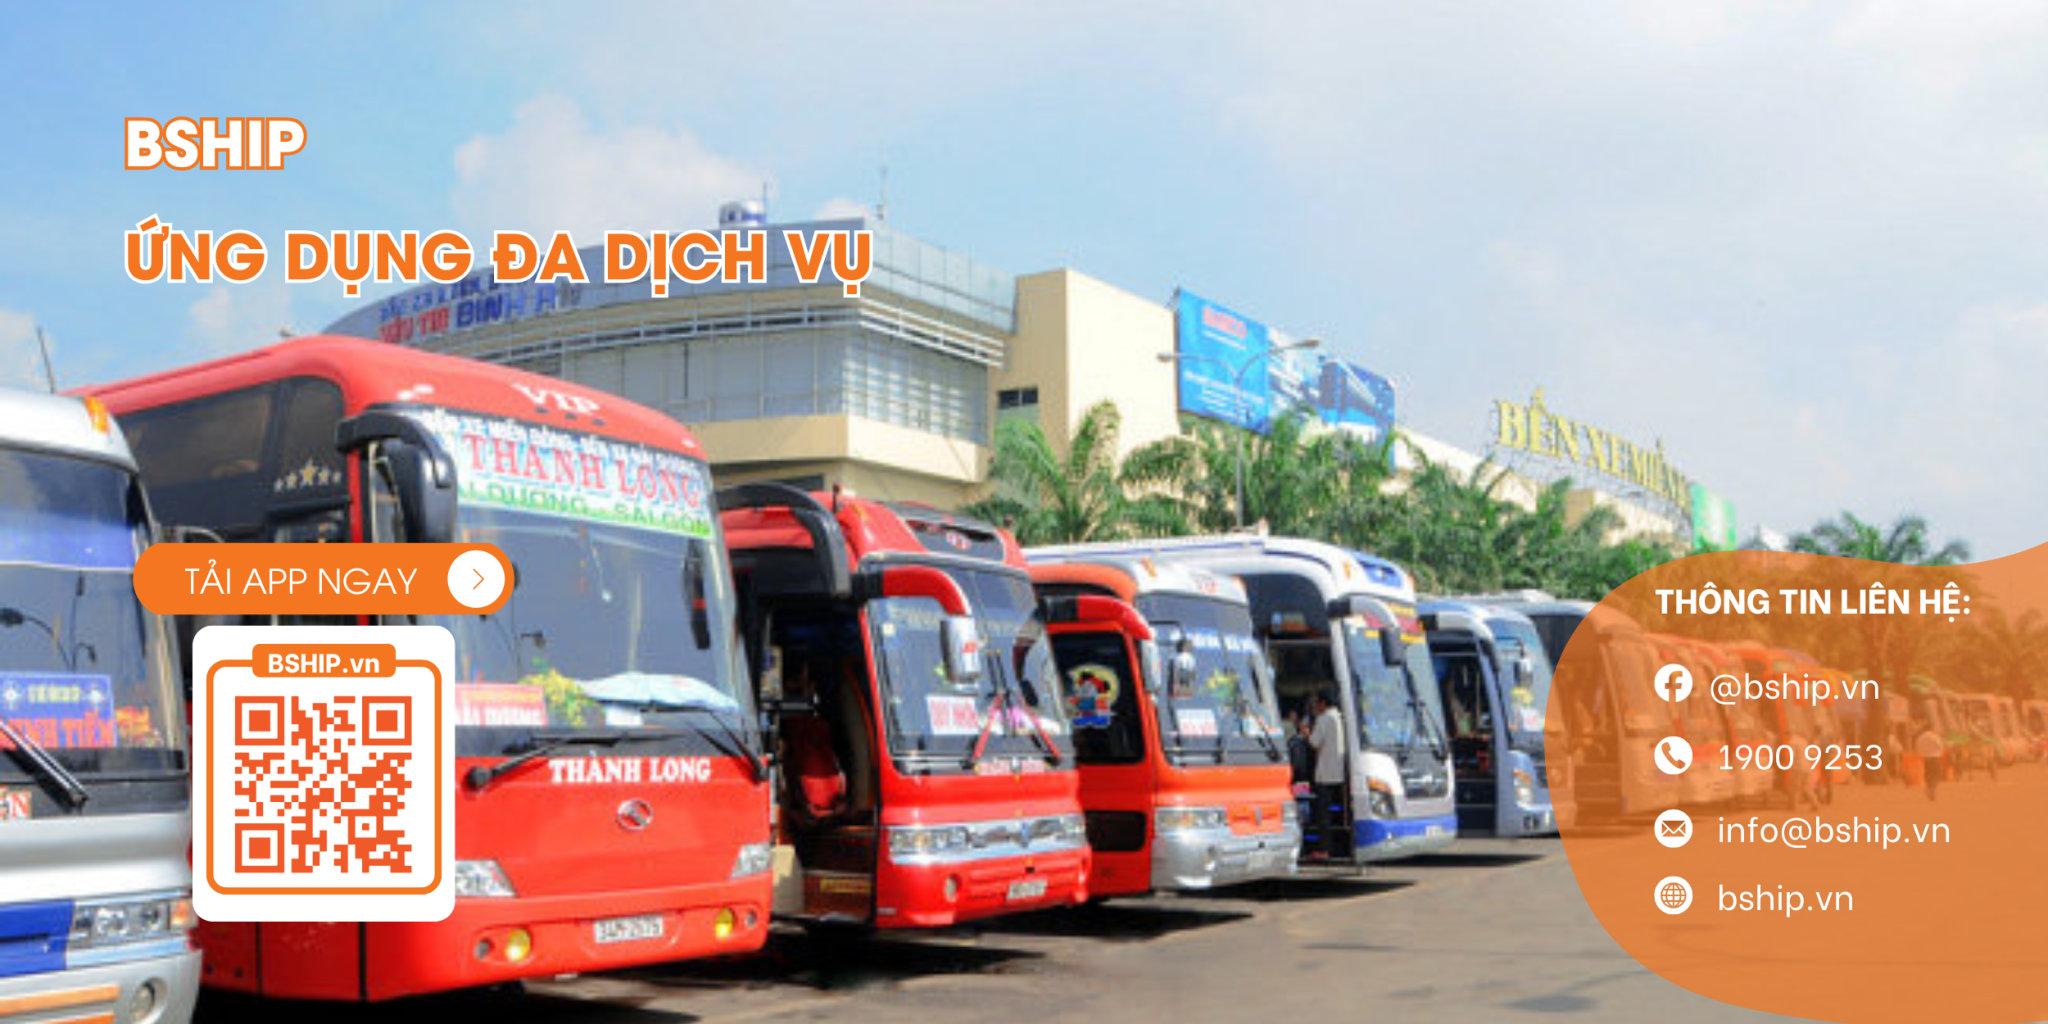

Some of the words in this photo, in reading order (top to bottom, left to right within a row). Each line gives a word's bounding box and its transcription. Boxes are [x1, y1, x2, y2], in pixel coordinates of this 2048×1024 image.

[1495, 385, 1580, 463] BẾN
[1582, 424, 1628, 479] XE
[548, 750, 642, 783] THÀNH
[648, 757, 712, 782] LONG
